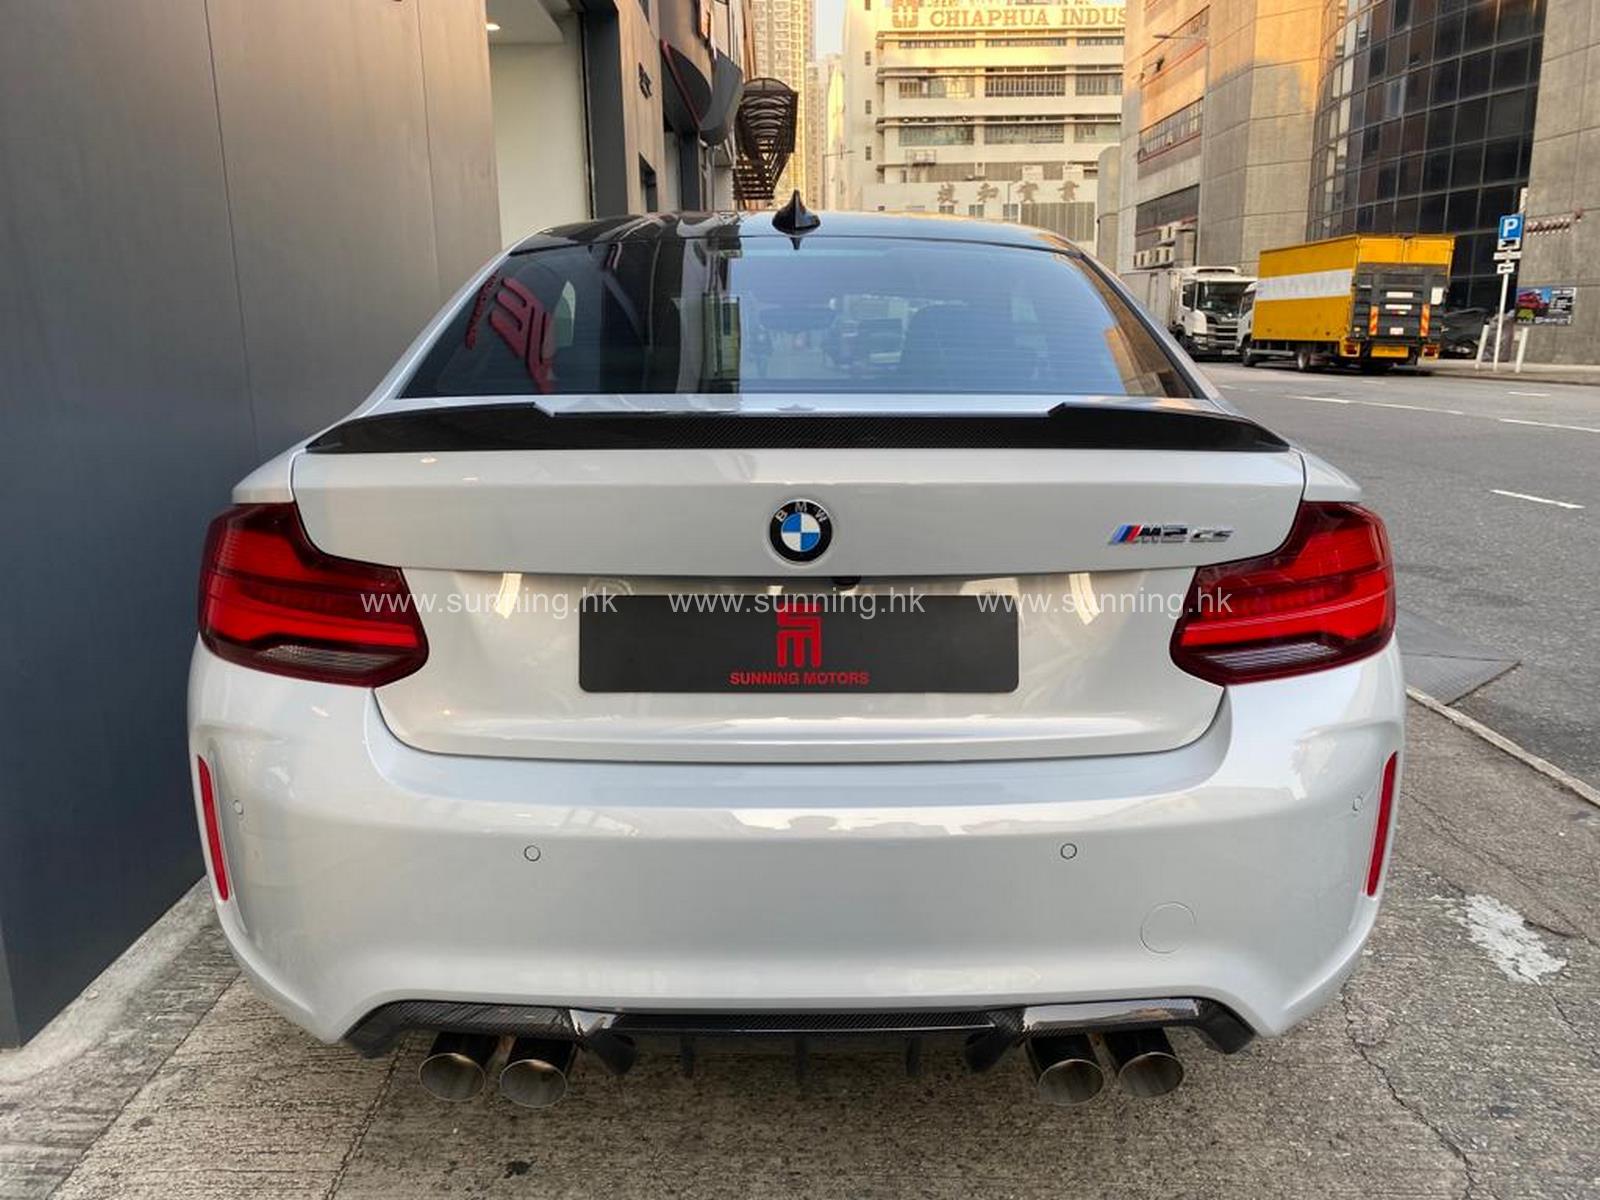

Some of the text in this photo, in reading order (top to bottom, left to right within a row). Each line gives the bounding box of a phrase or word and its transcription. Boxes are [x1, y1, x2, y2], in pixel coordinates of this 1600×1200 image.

[930, 8, 1050, 28] CHIAPHUA
[1502, 218, 1519, 237] P
[775, 501, 828, 523] BMW
[729, 671, 870, 686] SUNNING MOTORS
